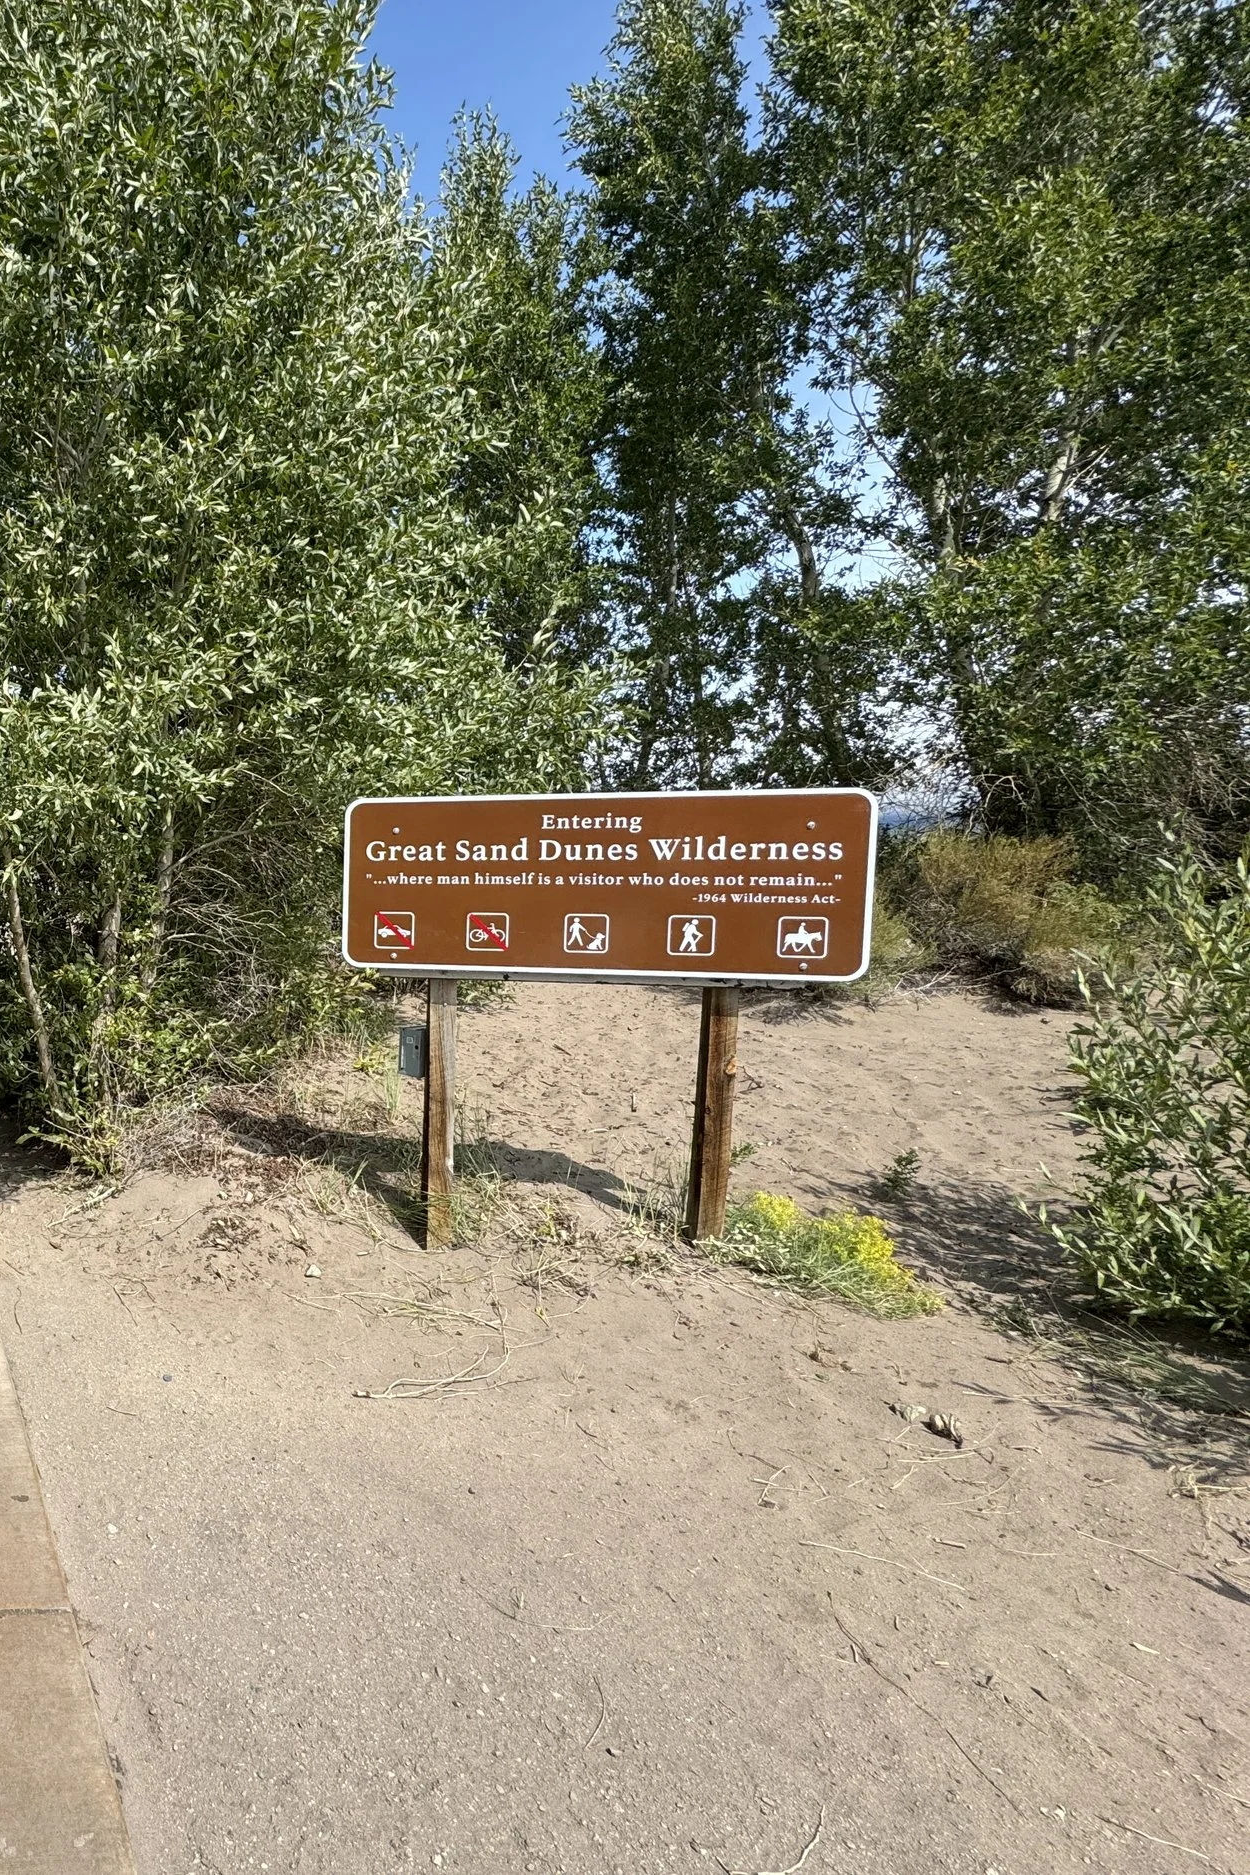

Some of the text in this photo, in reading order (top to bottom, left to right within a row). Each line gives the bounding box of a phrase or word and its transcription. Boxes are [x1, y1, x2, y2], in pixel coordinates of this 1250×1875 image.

[542, 813, 642, 833] Entering
[366, 836, 843, 861] Great Sand Dunes Wilderness
[366, 872, 842, 886] "...where man himself is a visitor who does not remain..."
[692, 893, 841, 903] -1964 Wilderness Act-
